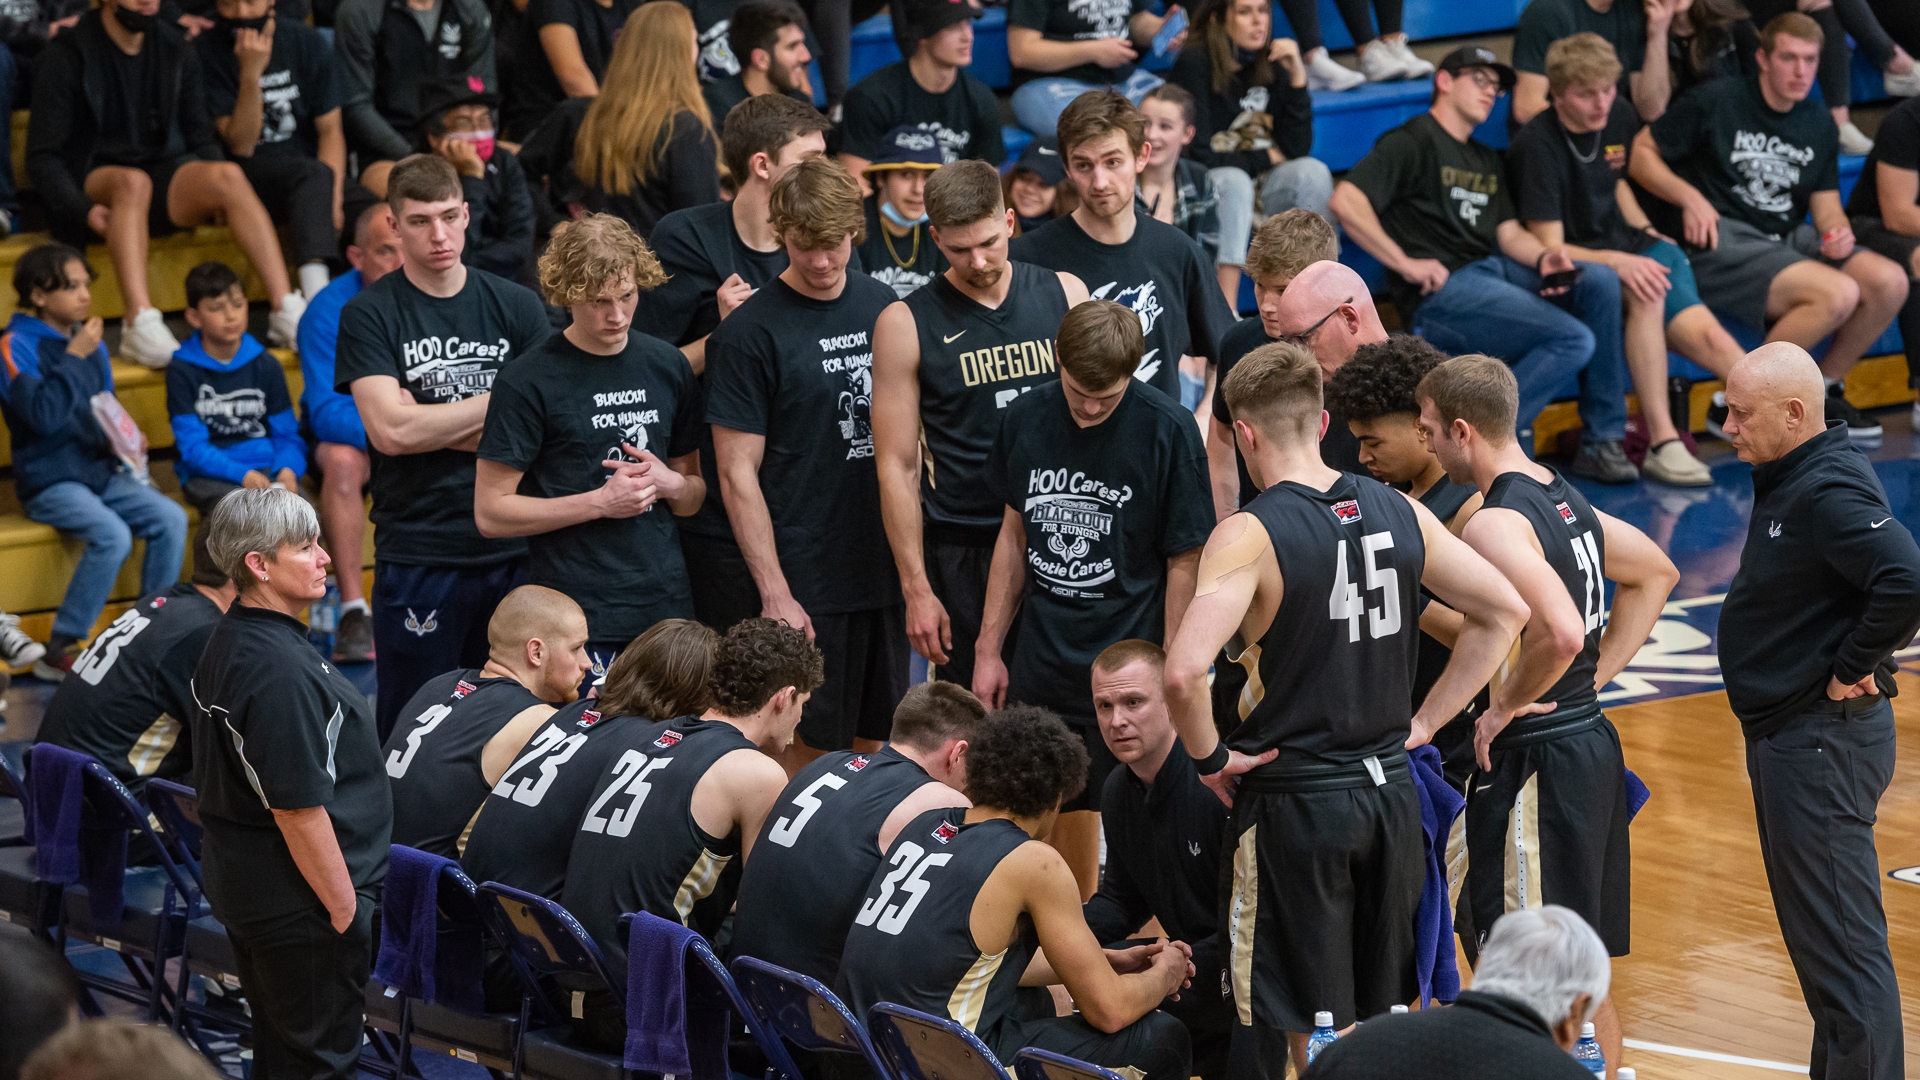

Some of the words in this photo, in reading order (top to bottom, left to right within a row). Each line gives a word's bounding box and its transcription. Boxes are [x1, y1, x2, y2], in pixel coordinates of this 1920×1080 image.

[445, 336, 511, 363] Cares?
[819, 331, 868, 352] BLACKOUT
[822, 357, 846, 374] FOR
[844, 352, 873, 370] HUNG
[960, 338, 1056, 388] OREGON
[434, 385, 456, 398] FOR
[592, 388, 647, 408] BLACKOUT
[591, 412, 618, 430] FOR
[617, 409, 660, 427] HUNGER
[1028, 467, 1068, 494] HOO
[1069, 471, 1134, 509] Cares?
[1031, 502, 1114, 536] BLACKOUT
[1041, 522, 1059, 533] FOR
[1060, 523, 1101, 542] HUNGER
[1068, 557, 1114, 580] Cares
[1329, 530, 1402, 643] 45
[1570, 530, 1606, 636] 21
[71, 607, 152, 687] 33
[385, 703, 453, 779] 3
[491, 722, 589, 808] 23
[581, 748, 675, 838] 25
[768, 771, 849, 849] 5
[855, 840, 954, 936] 35
